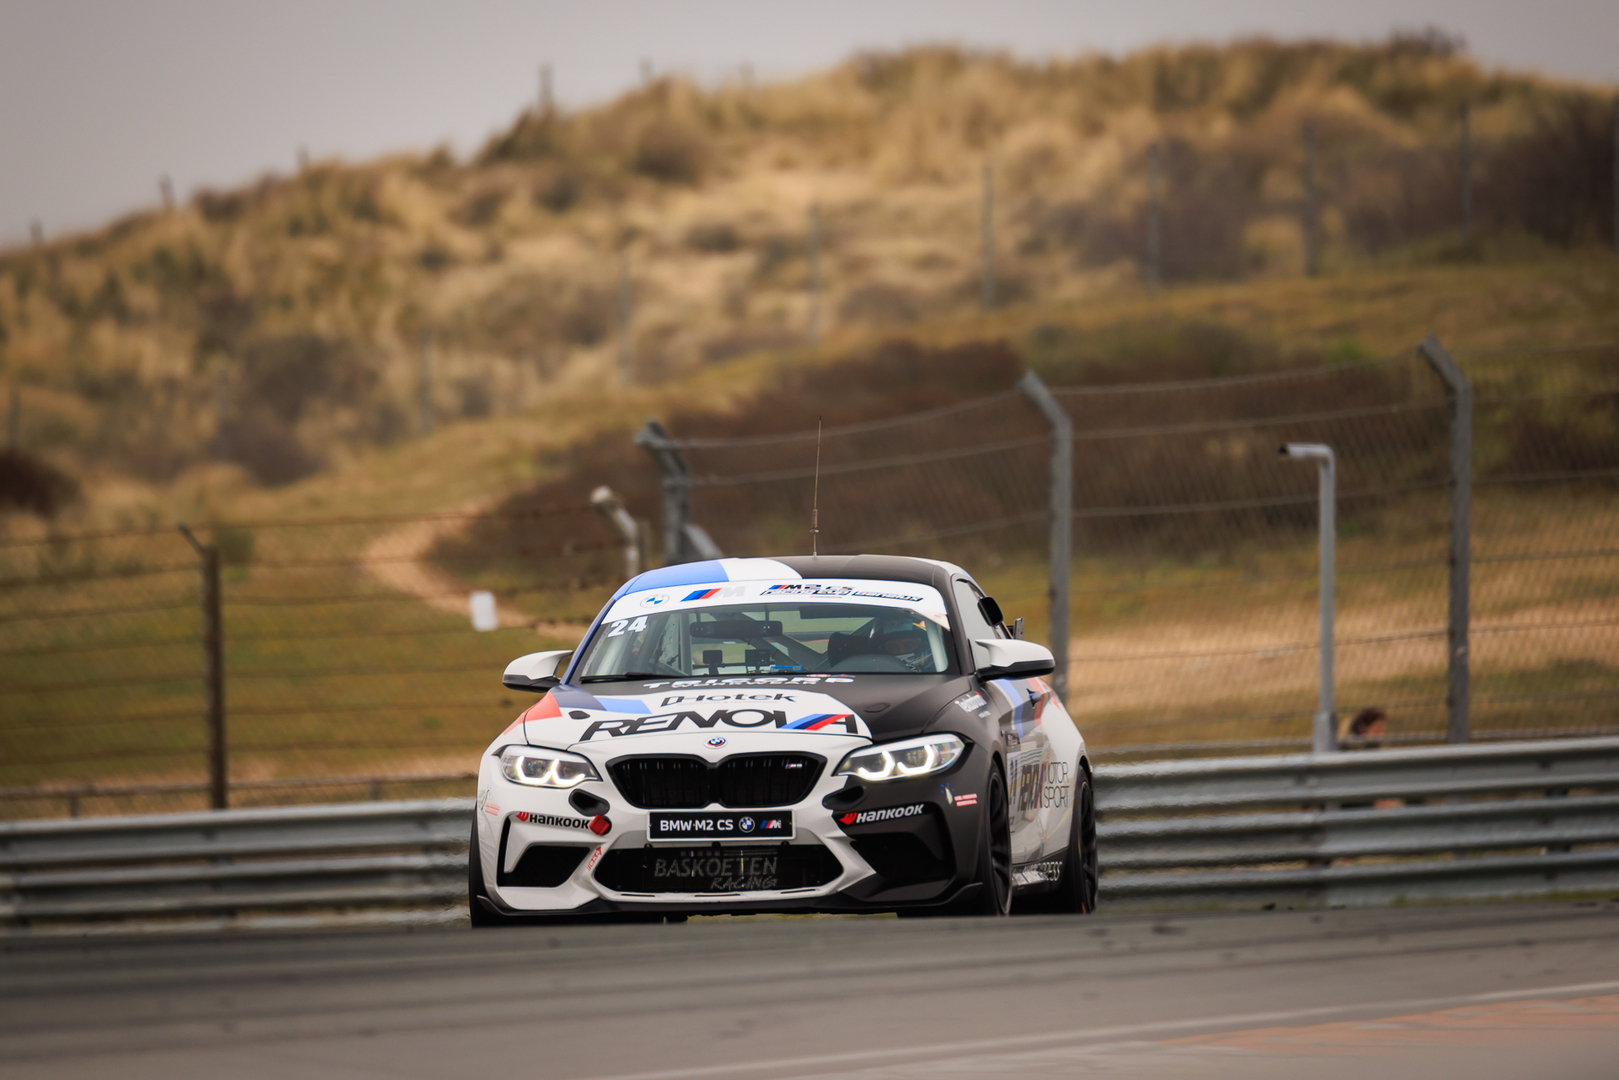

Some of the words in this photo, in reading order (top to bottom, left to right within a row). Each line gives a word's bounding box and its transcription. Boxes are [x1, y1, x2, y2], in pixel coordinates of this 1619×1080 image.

[607, 615, 649, 638] 24
[643, 677, 855, 689] TRICORP
[578, 709, 859, 742] RENOVA
[1043, 785, 1070, 809] SPORT
[660, 820, 692, 832] BMW
[695, 819, 714, 831] M2
[717, 819, 734, 831] CS
[653, 856, 778, 878] BASKOETEN
